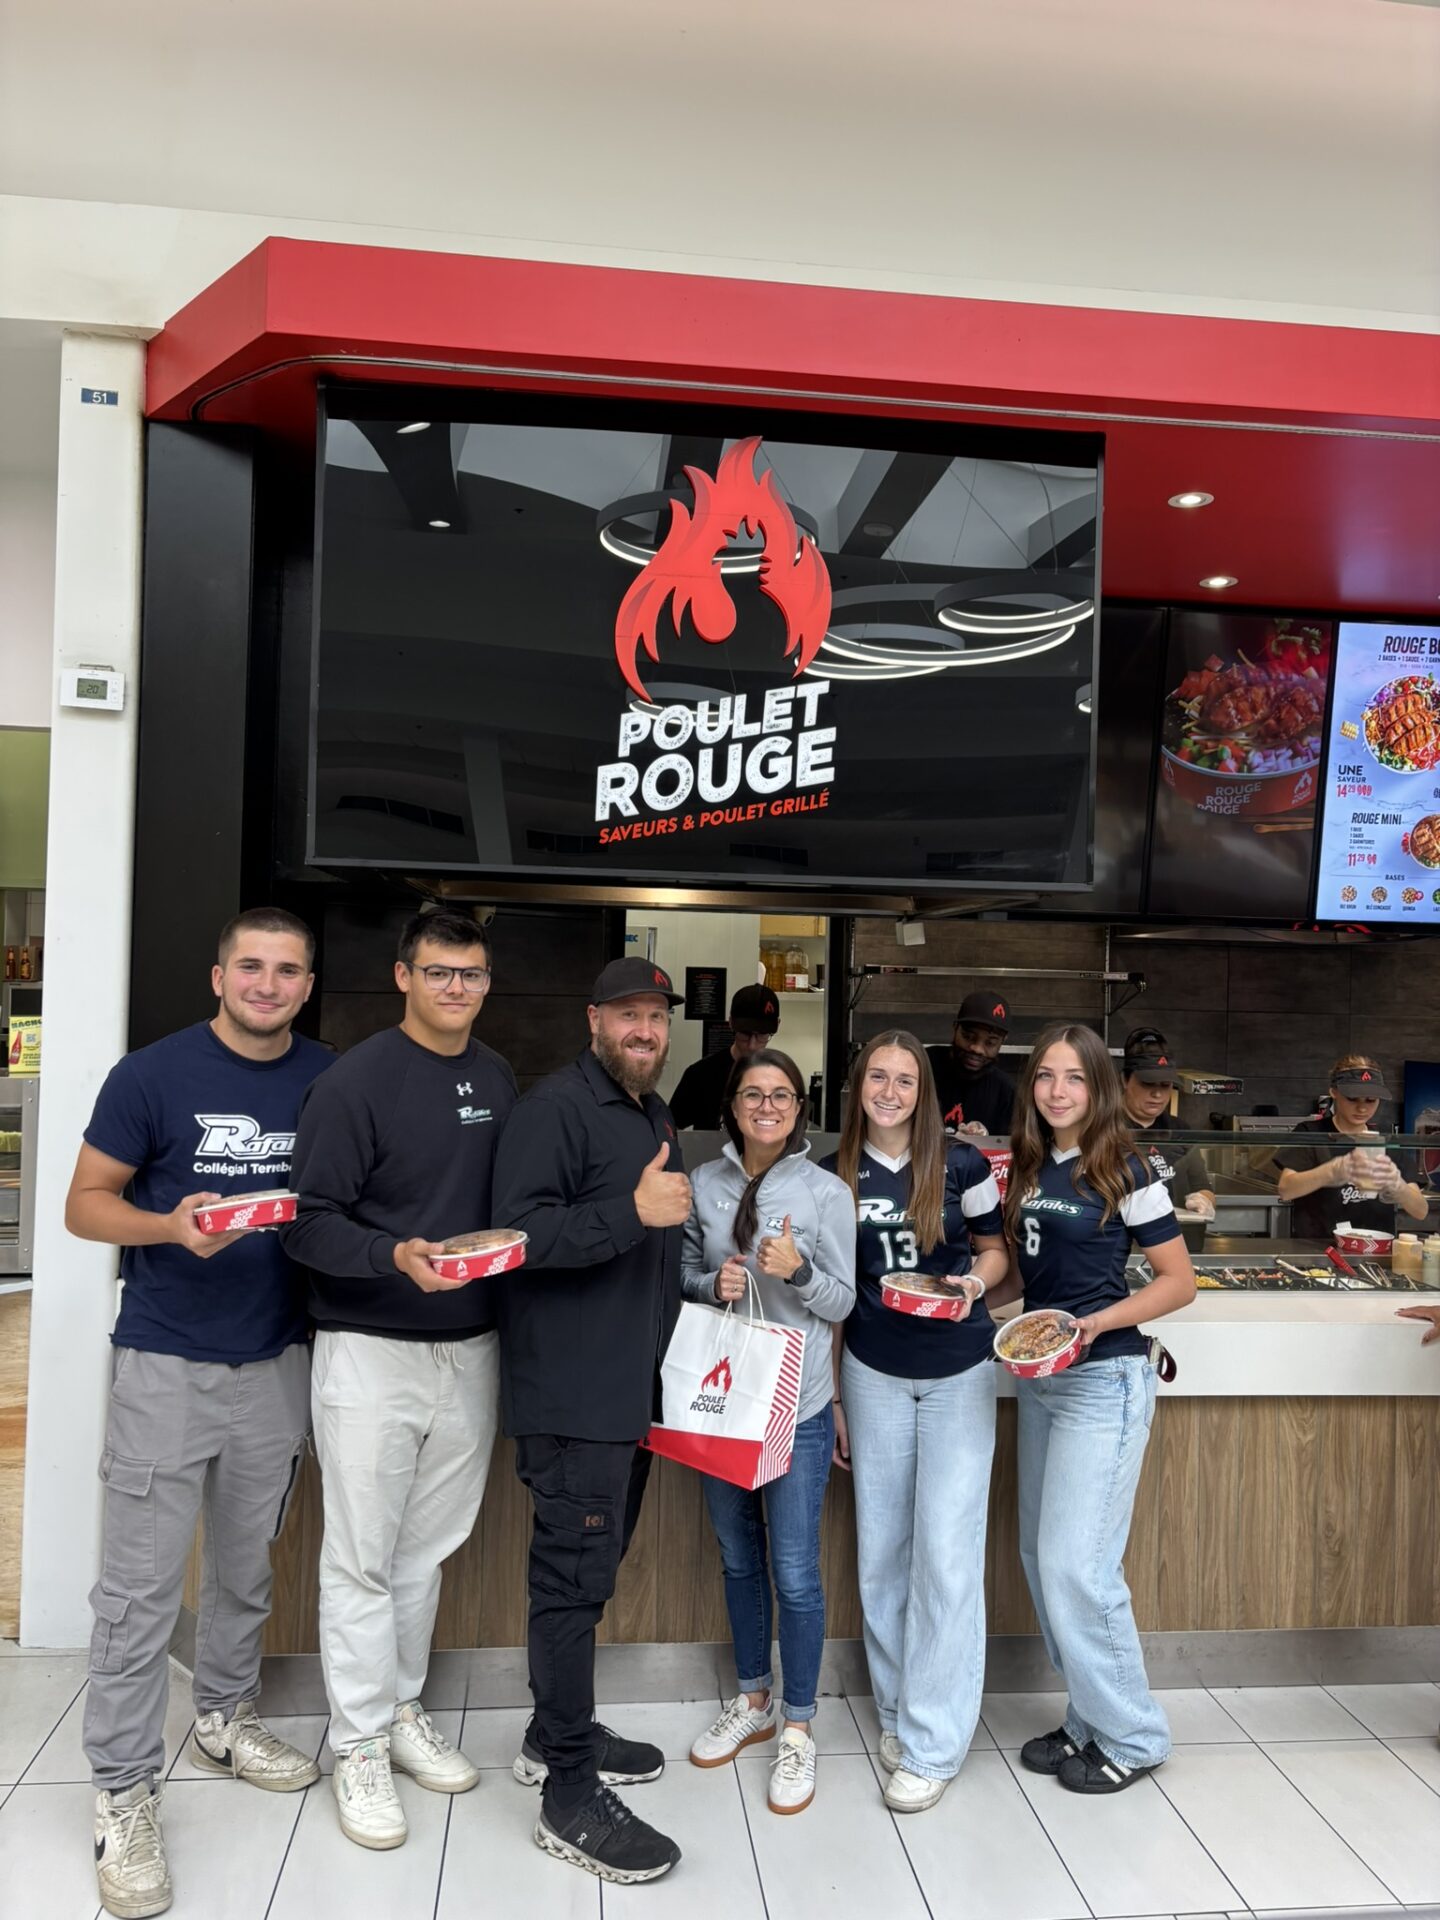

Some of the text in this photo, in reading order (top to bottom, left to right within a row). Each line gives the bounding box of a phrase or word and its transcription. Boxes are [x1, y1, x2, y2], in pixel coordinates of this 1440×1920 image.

[92, 391, 107, 404] 51
[1383, 636, 1427, 654] ROUGE
[618, 680, 830, 757] POULET
[595, 727, 836, 821] ROUGE
[1338, 765, 1363, 776] UNE
[1216, 782, 1262, 796] ROUGE
[1206, 794, 1251, 805] ROUGE
[599, 787, 831, 845] SAVEURS & POULET GRILLÉ
[1351, 813, 1402, 825] ROUGE MINI
[193, 1162, 247, 1176] Collégial
[1024, 1217, 1040, 1256] 6
[879, 1231, 918, 1269] 13
[697, 1394, 726, 1404] POULET
[690, 1401, 726, 1415] ROUGE
